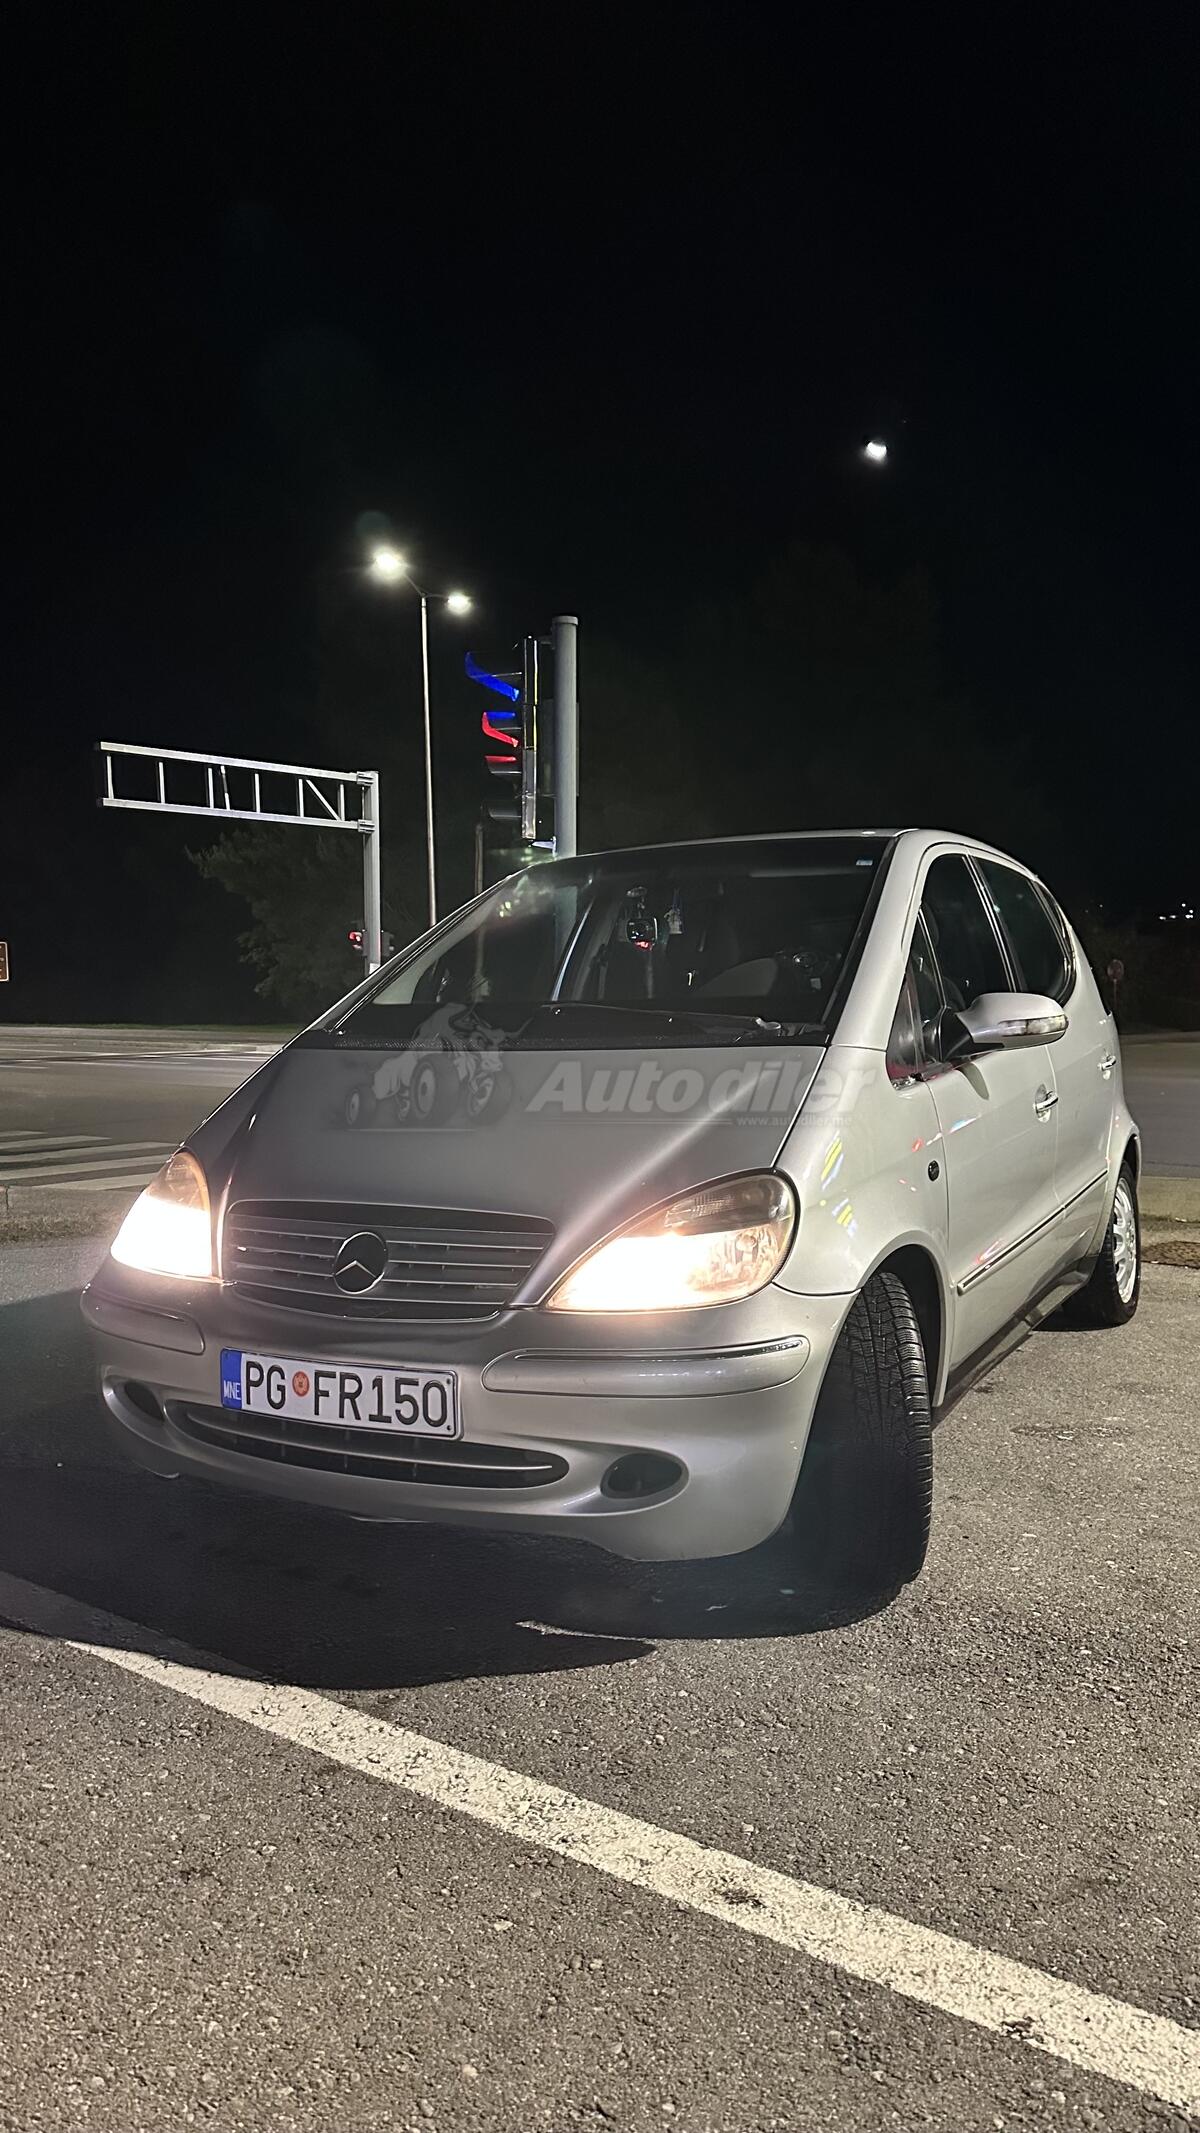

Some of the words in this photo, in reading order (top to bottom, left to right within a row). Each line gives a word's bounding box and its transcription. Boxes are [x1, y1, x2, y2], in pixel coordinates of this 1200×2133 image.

[223, 1380, 241, 1401] MNE
[245, 1361, 286, 1410] PG
[314, 1369, 447, 1427] FR150
